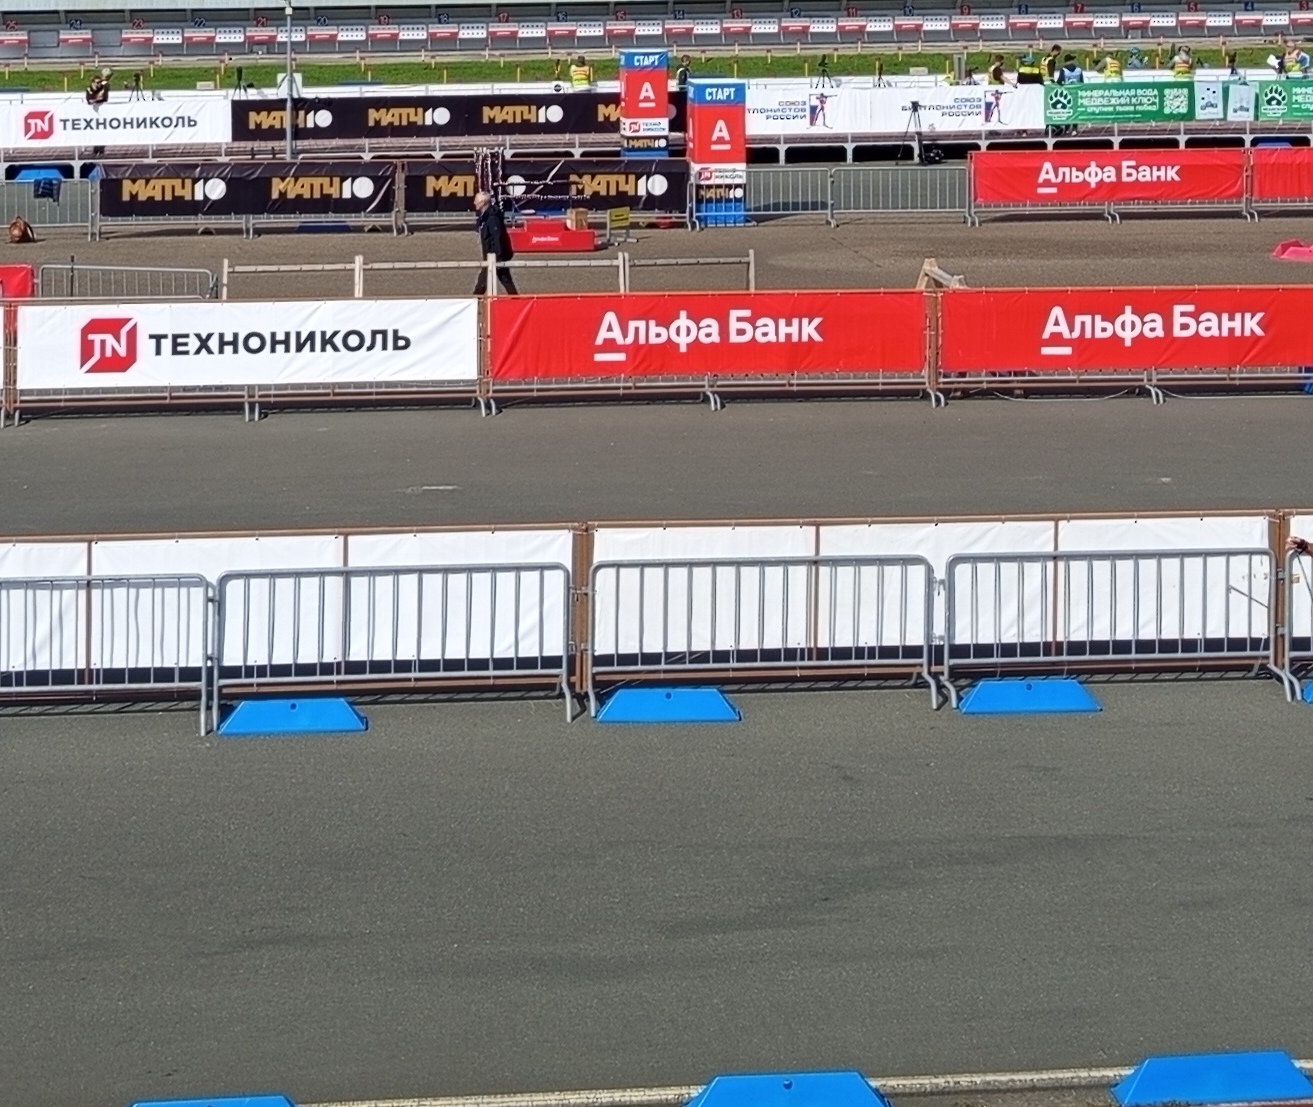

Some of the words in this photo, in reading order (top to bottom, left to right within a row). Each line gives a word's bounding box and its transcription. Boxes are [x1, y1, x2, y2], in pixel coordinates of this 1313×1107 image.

[634, 55, 659, 66] СТАРТ
[705, 88, 735, 100] СТАРТ
[1137, 88, 1159, 96] ВОДА
[1079, 96, 1131, 106] МЕДВЕЖИЙ
[1131, 96, 1159, 104] КЛЮЧ
[941, 110, 982, 118] РОССИИ
[59, 116, 197, 132] ТЕХНОНИКОЛЬ
[1037, 160, 1116, 190] Альфа
[1121, 160, 1181, 182] Банк
[594, 311, 721, 352] Альфа
[729, 310, 823, 344] Банк
[1041, 305, 1165, 347] Альфа
[1173, 304, 1265, 338] Банк
[149, 328, 412, 356] ТЕХНОНИКОЛЬ
